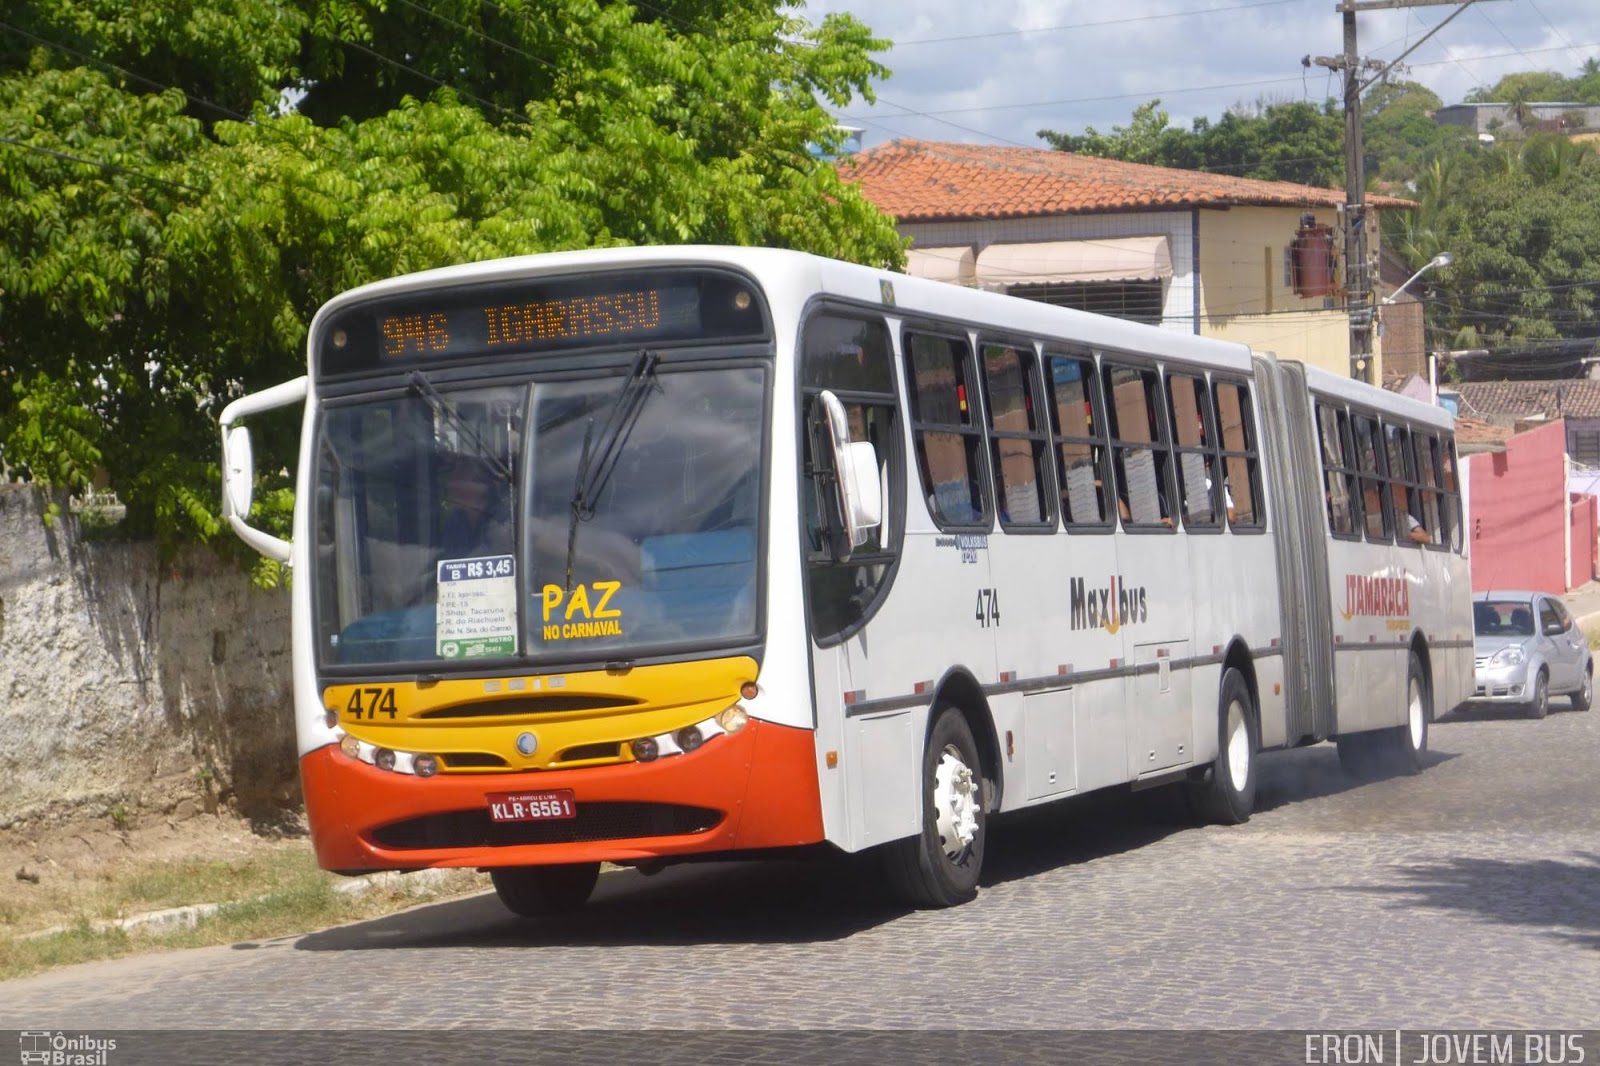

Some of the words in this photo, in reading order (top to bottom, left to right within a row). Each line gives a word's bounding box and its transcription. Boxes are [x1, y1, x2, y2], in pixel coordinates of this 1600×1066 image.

[383, 312, 449, 355] 946
[485, 289, 660, 345] IGARASSU
[451, 570, 461, 580] B
[467, 562, 484, 577] R$
[485, 559, 511, 578] 3,45
[470, 607, 505, 615] Tacaruna
[542, 581, 622, 622] PAZ
[975, 588, 1000, 628] 474
[467, 616, 506, 624] Riachuelo
[489, 625, 512, 633] Carmo
[543, 625, 560, 641] NO
[562, 620, 622, 639] CARNAVAL
[347, 687, 398, 719] 474
